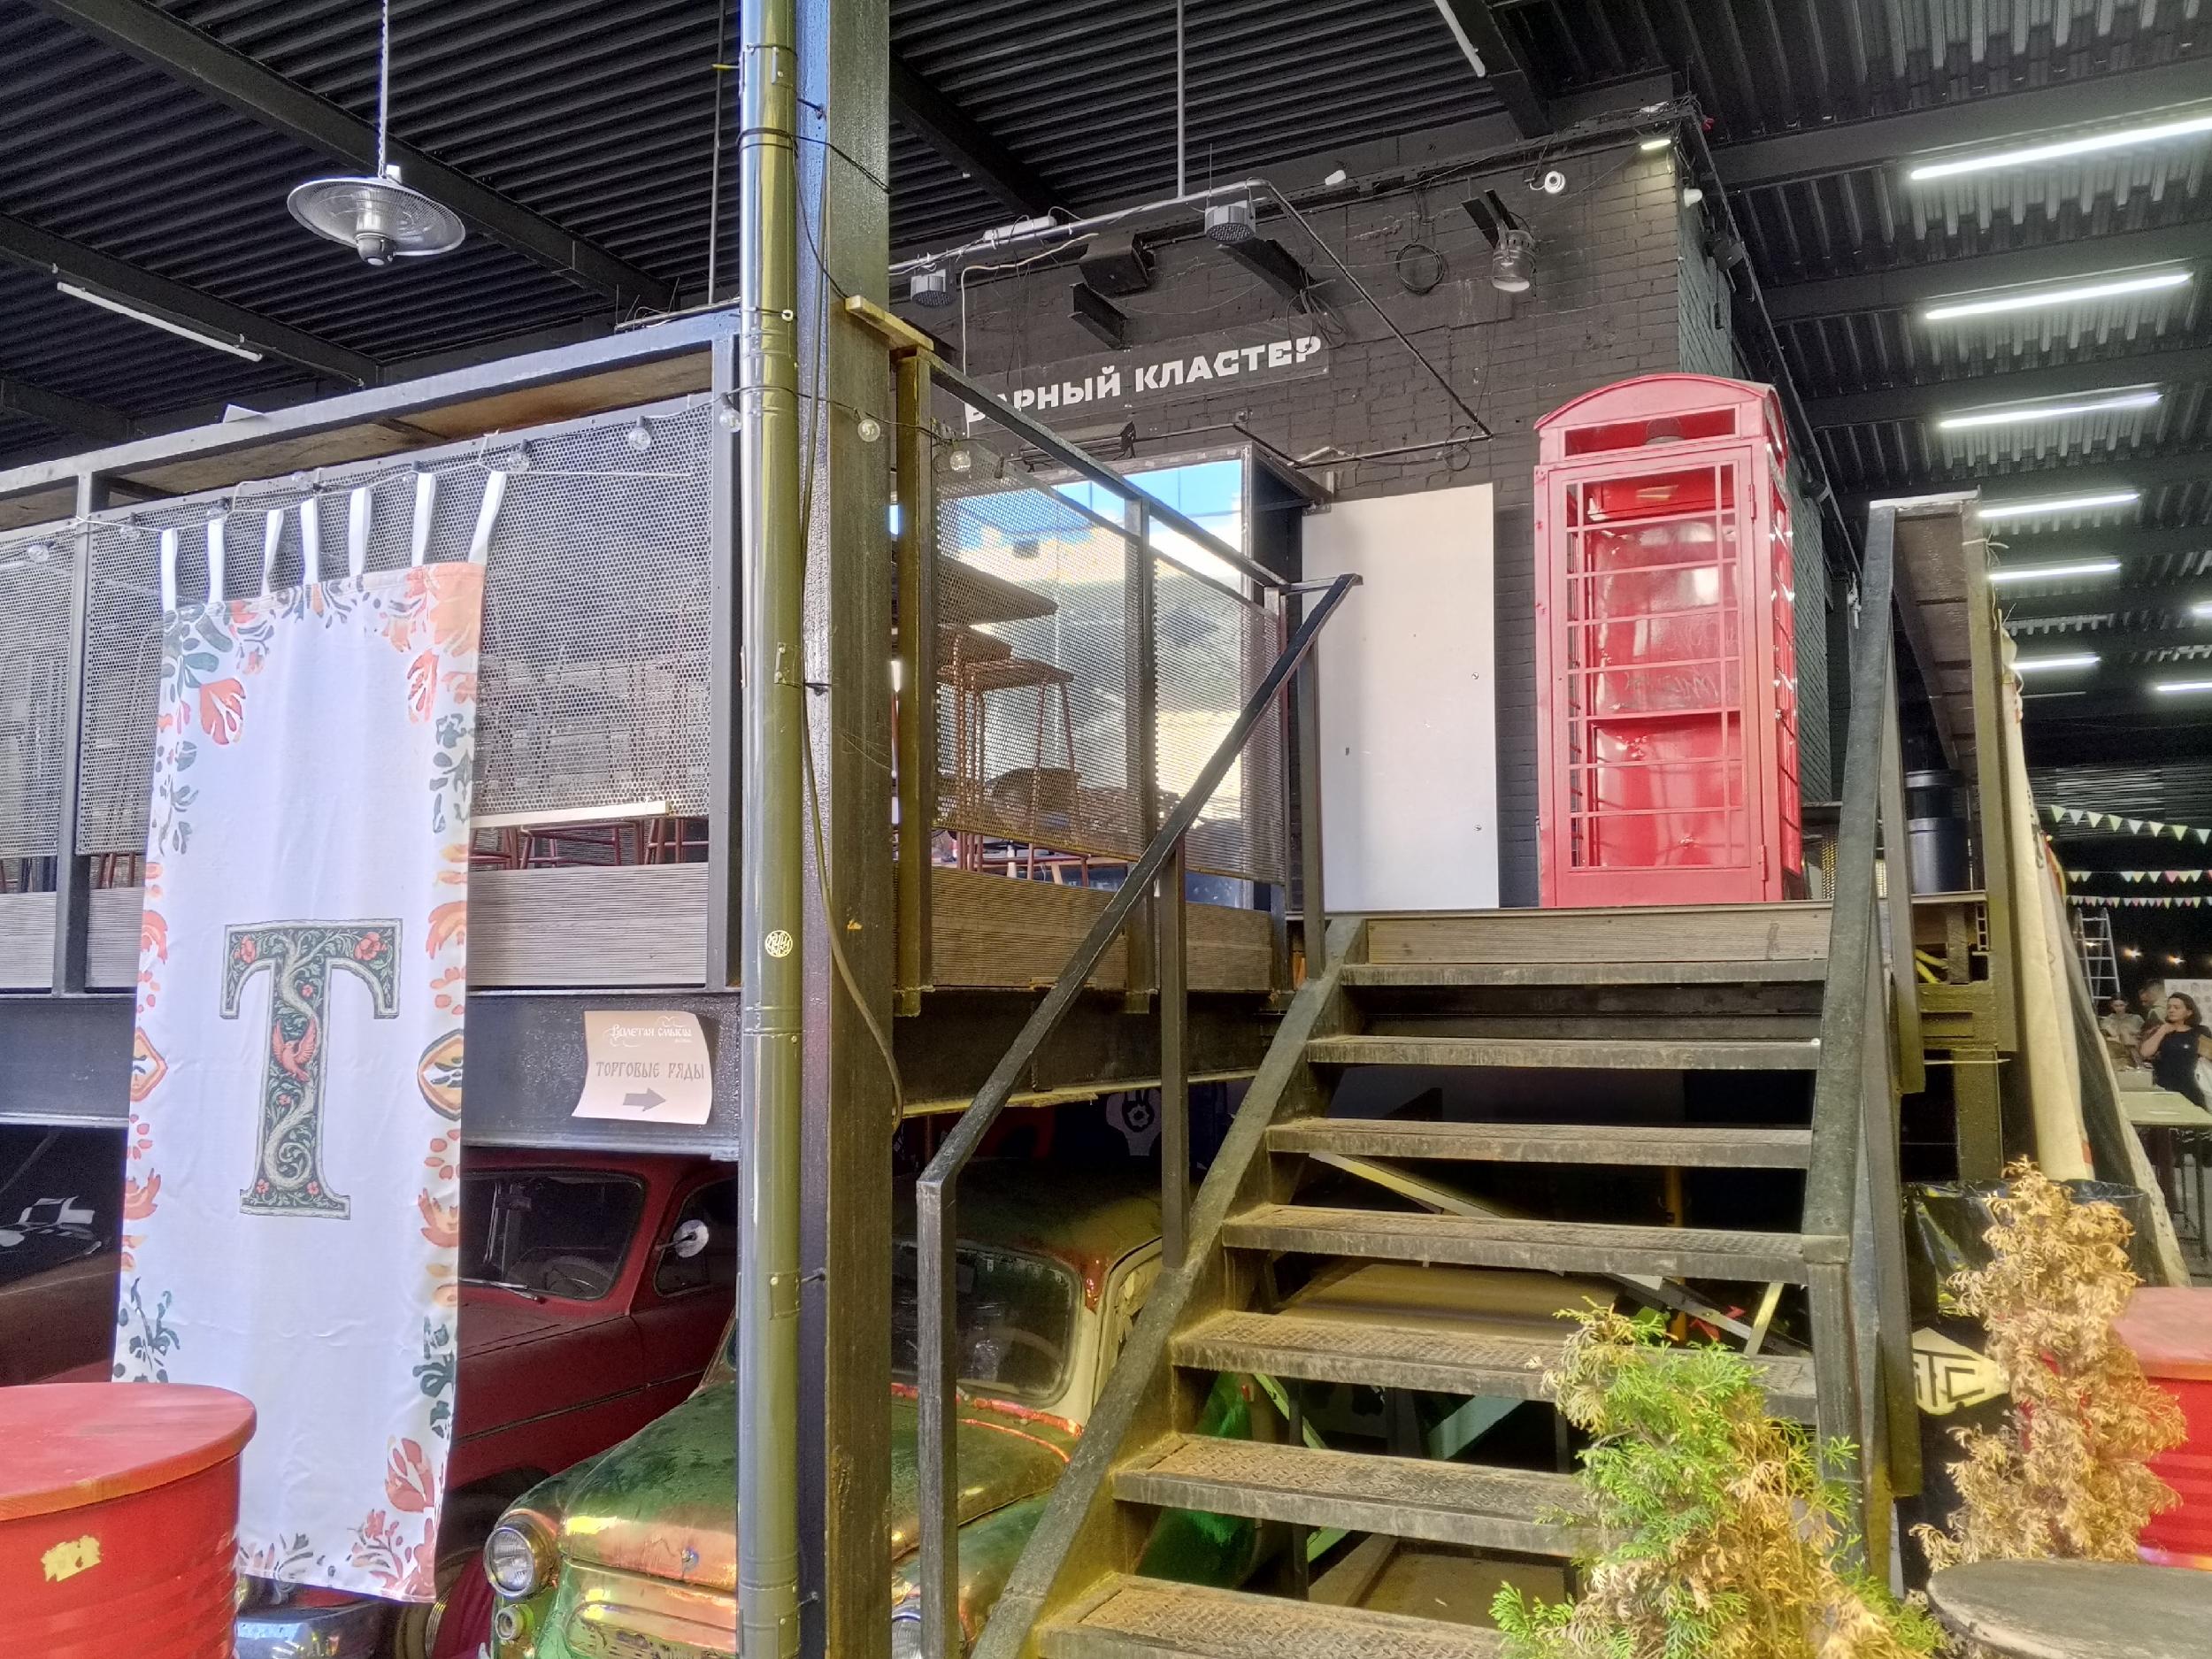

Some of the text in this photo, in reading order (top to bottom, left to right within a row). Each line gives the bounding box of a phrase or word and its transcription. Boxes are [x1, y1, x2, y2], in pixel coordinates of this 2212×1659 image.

[965, 336, 1322, 422] РНЫЙ КЛАСТЕР
[595, 1061, 704, 1082] ТОРГОВЫЕ РЯДЫ
